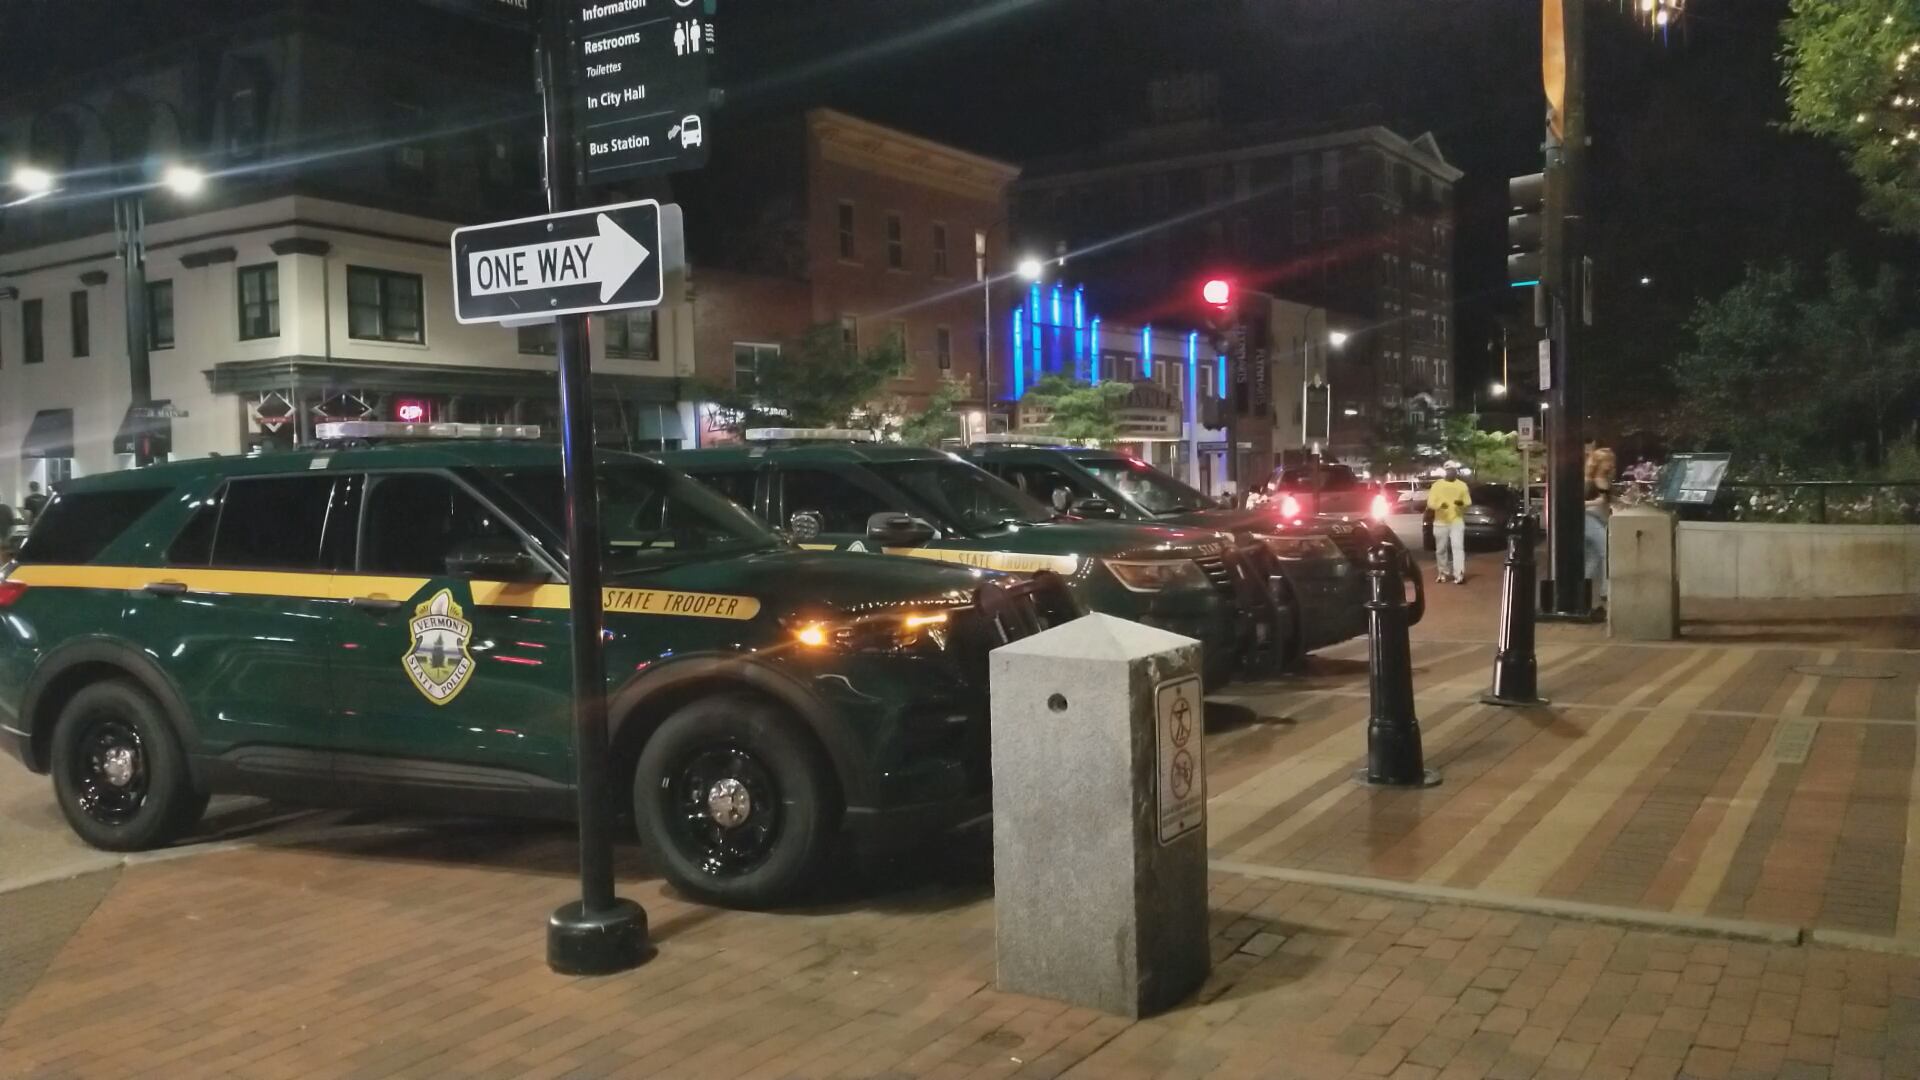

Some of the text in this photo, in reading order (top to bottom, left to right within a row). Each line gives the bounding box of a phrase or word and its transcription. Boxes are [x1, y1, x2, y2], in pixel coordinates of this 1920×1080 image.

[582, 0, 646, 21] Information
[584, 32, 641, 55] Restrooms
[586, 62, 622, 78] Toilettes
[587, 84, 645, 109] In City Hall
[589, 135, 650, 156] Bus Station
[477, 243, 593, 290] ONE WAY
[604, 590, 738, 616] STATE TROOPER
[416, 618, 464, 633] VERMONT
[410, 657, 468, 696] STATE POLICE
